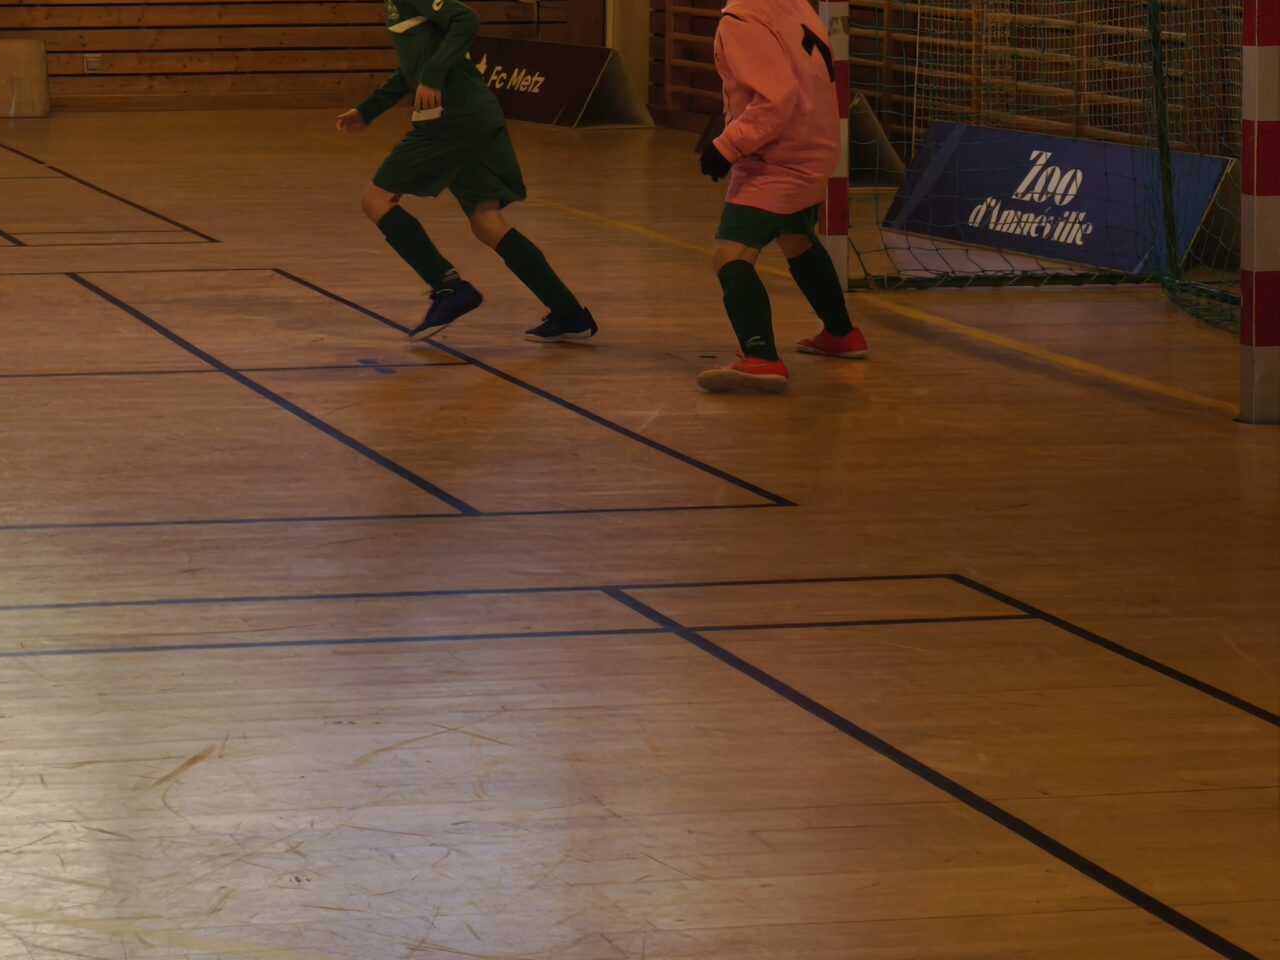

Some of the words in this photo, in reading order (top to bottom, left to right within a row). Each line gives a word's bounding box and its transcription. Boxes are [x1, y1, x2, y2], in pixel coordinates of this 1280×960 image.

[487, 65, 508, 89] Fc
[506, 67, 546, 94] Metz
[1012, 150, 1083, 206] Zoo
